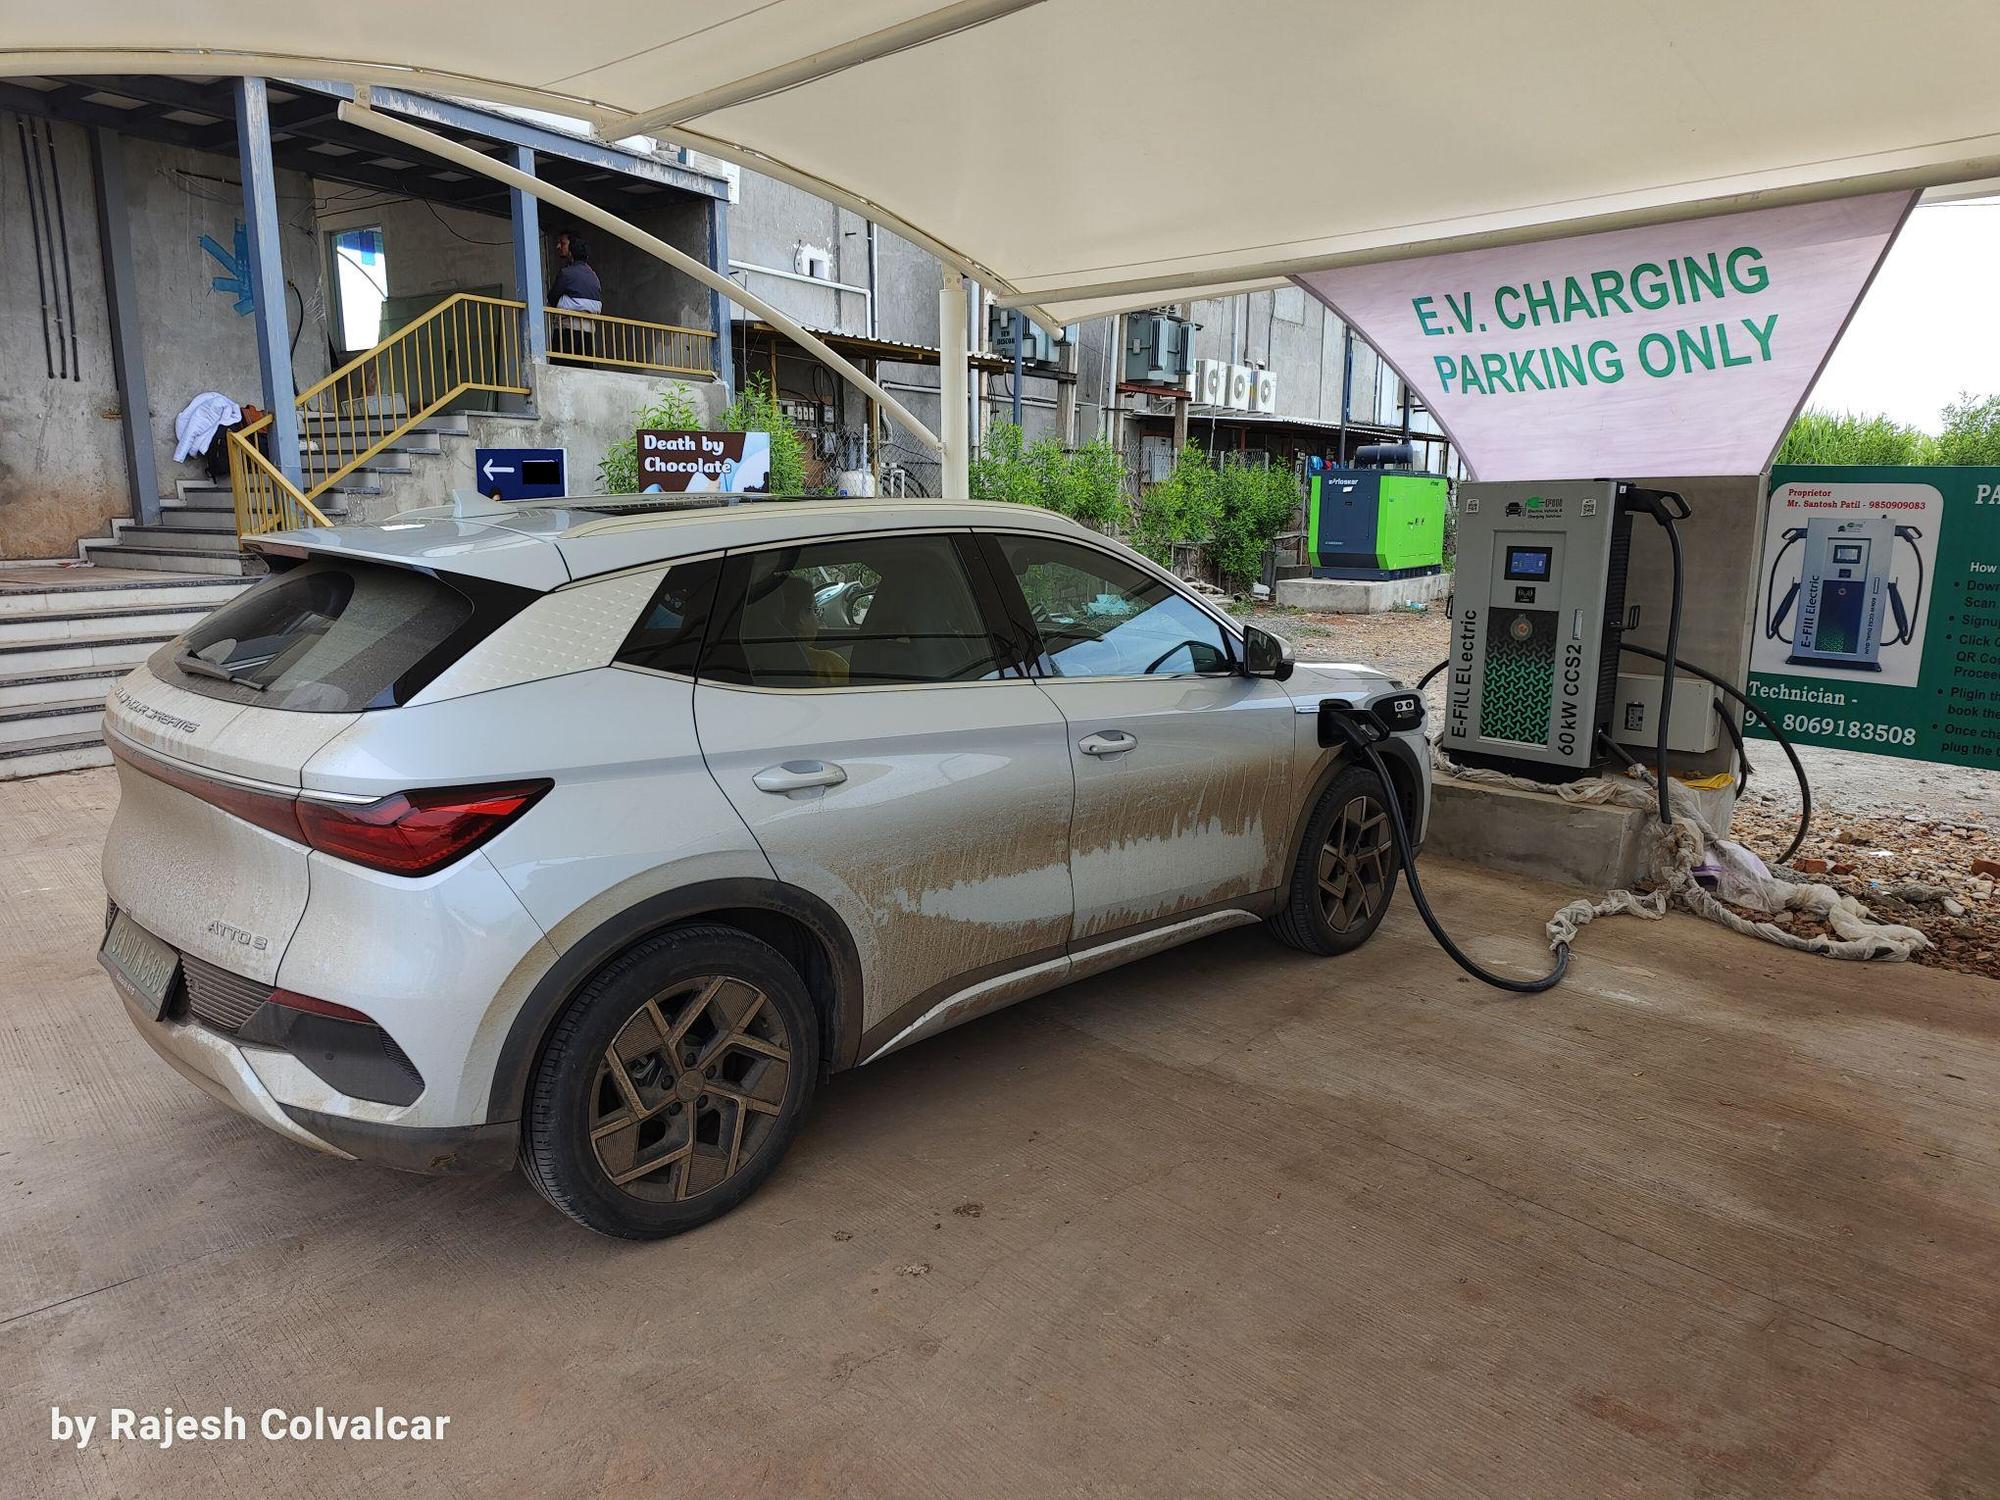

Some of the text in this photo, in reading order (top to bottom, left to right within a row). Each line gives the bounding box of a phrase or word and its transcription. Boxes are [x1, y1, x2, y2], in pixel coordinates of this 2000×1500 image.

[1411, 246, 1770, 336] E.V. CHARGING
[1433, 313, 1780, 395] PARKING ONLY
[643, 434, 725, 456] Death by
[644, 456, 731, 473] Chocolate
[1788, 488, 1832, 498] Proprietor
[1787, 499, 1801, 508] Mr.
[1803, 500, 1838, 509] Santosh
[1839, 500, 1861, 509] Patil
[1868, 501, 1927, 510] 9850909083
[1969, 561, 1998, 573] How
[1963, 596, 1997, 609] Scan
[1800, 575, 1820, 648] E-Fill Electric
[1961, 614, 2000, 629] Signu
[1959, 633, 1991, 647] Click
[1956, 651, 1976, 663] QR
[1563, 644, 1582, 697] CCS2
[1953, 666, 2000, 680] Procee
[1748, 680, 1846, 706] Technician
[1947, 703, 1979, 717] book
[1782, 713, 1917, 746] 8069183508
[1944, 723, 1977, 737] Once
[1941, 741, 1993, 756] plug the
